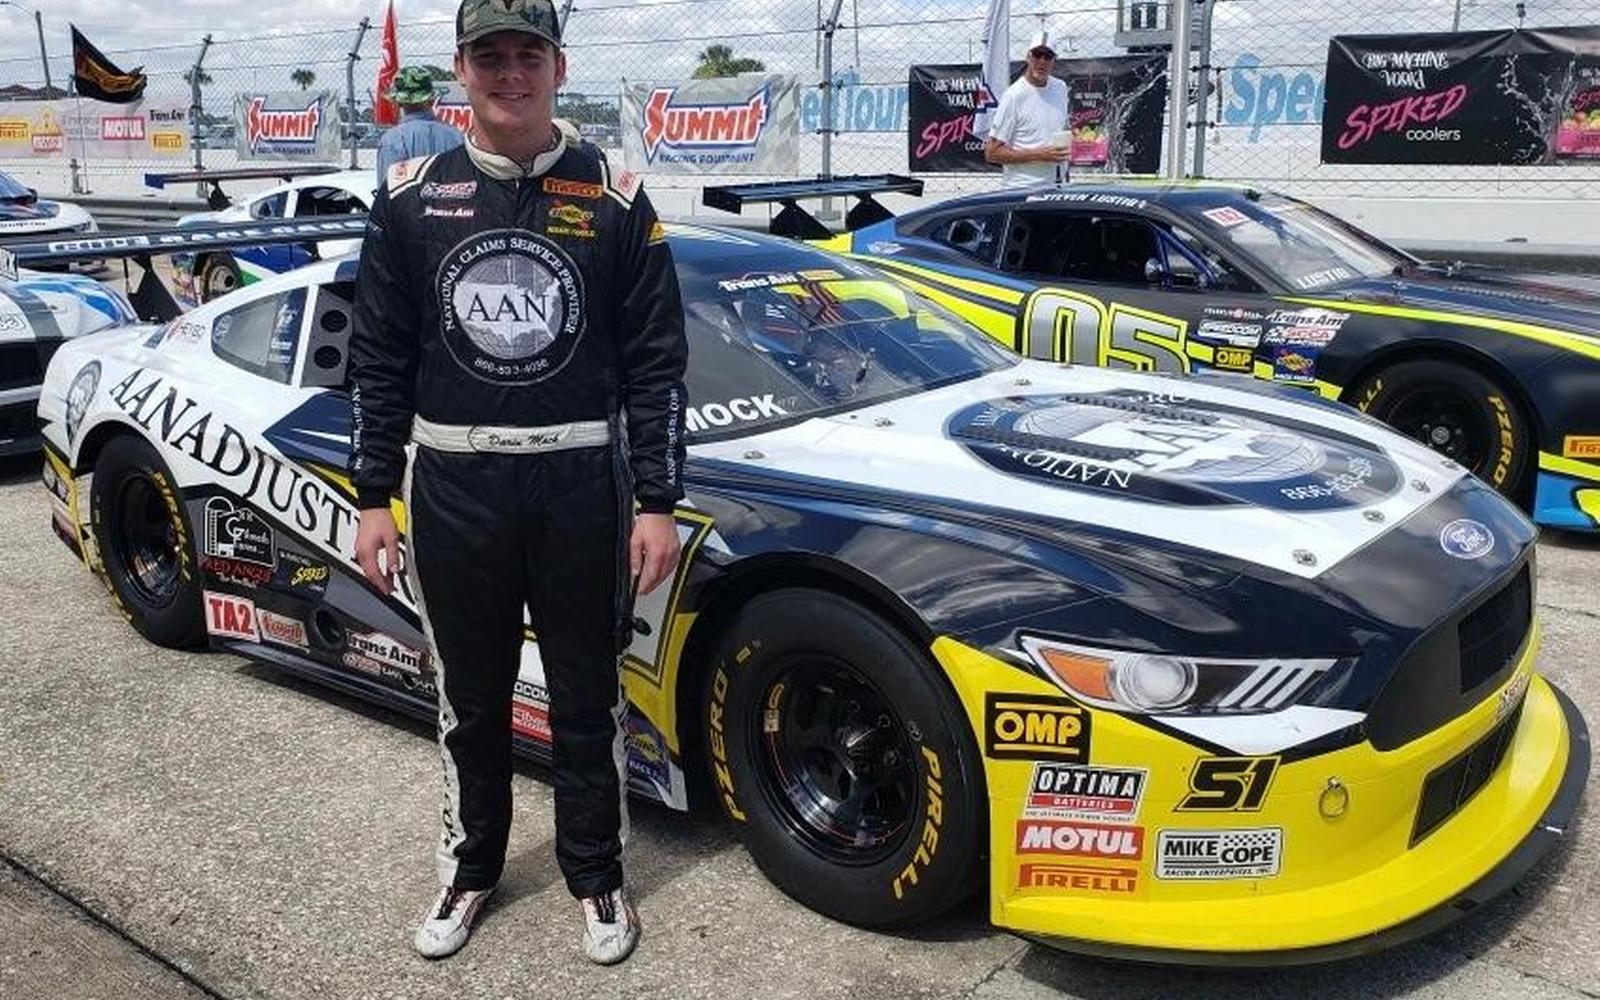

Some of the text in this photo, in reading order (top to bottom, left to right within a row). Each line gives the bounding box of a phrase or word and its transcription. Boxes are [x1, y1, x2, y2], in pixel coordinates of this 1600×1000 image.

[1389, 51, 1449, 70] MACHINE
[1380, 69, 1426, 89] VODKA
[103, 119, 144, 138] MOTUL
[1337, 84, 1467, 150] SPIKED
[916, 114, 975, 158] SPIK
[1406, 126, 1461, 140] coolers
[442, 236, 581, 334] NATIONAL CLAIMS SERVICE PROVIDER
[465, 293, 549, 323] AAN
[1216, 350, 1251, 368] OMP
[208, 597, 256, 635] TA2
[389, 645, 417, 668] Am
[994, 710, 1083, 746] OMP
[1038, 769, 1136, 798] OPTIMA
[892, 745, 944, 900] PIRELLI
[1021, 825, 1138, 855] MOTUL
[1163, 840, 1273, 863] MIKE COPE
[1018, 864, 1138, 893] PIRELLI
